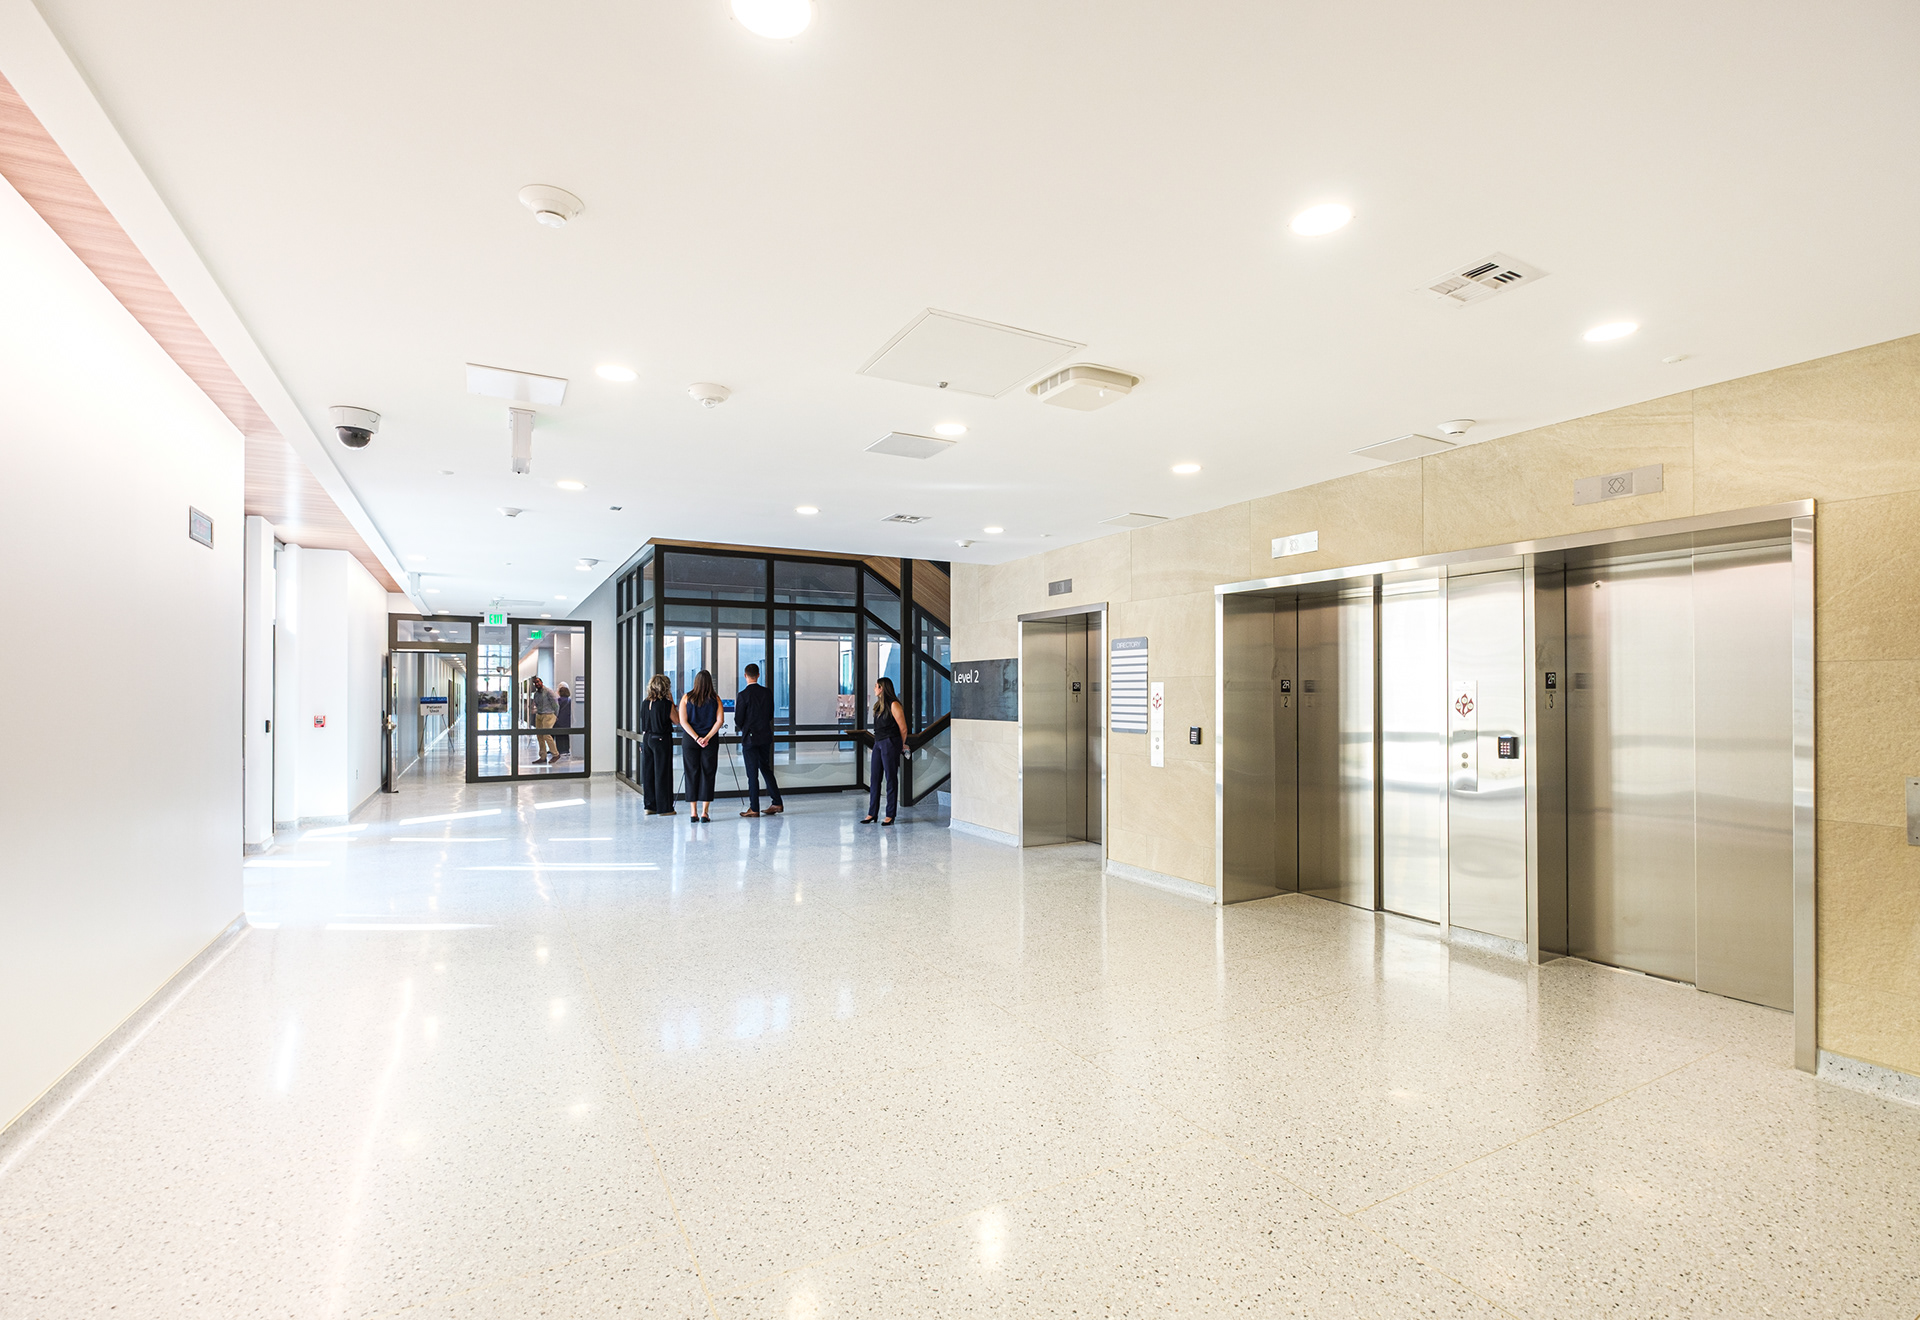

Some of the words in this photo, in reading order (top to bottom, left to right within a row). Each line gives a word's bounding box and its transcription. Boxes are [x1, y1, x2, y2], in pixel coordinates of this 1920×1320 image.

[489, 613, 503, 625] EXIT
[1116, 640, 1142, 649] DIRECTORY
[954, 669, 973, 684] Level
[974, 669, 980, 684] 2
[1283, 696, 1289, 708] 2
